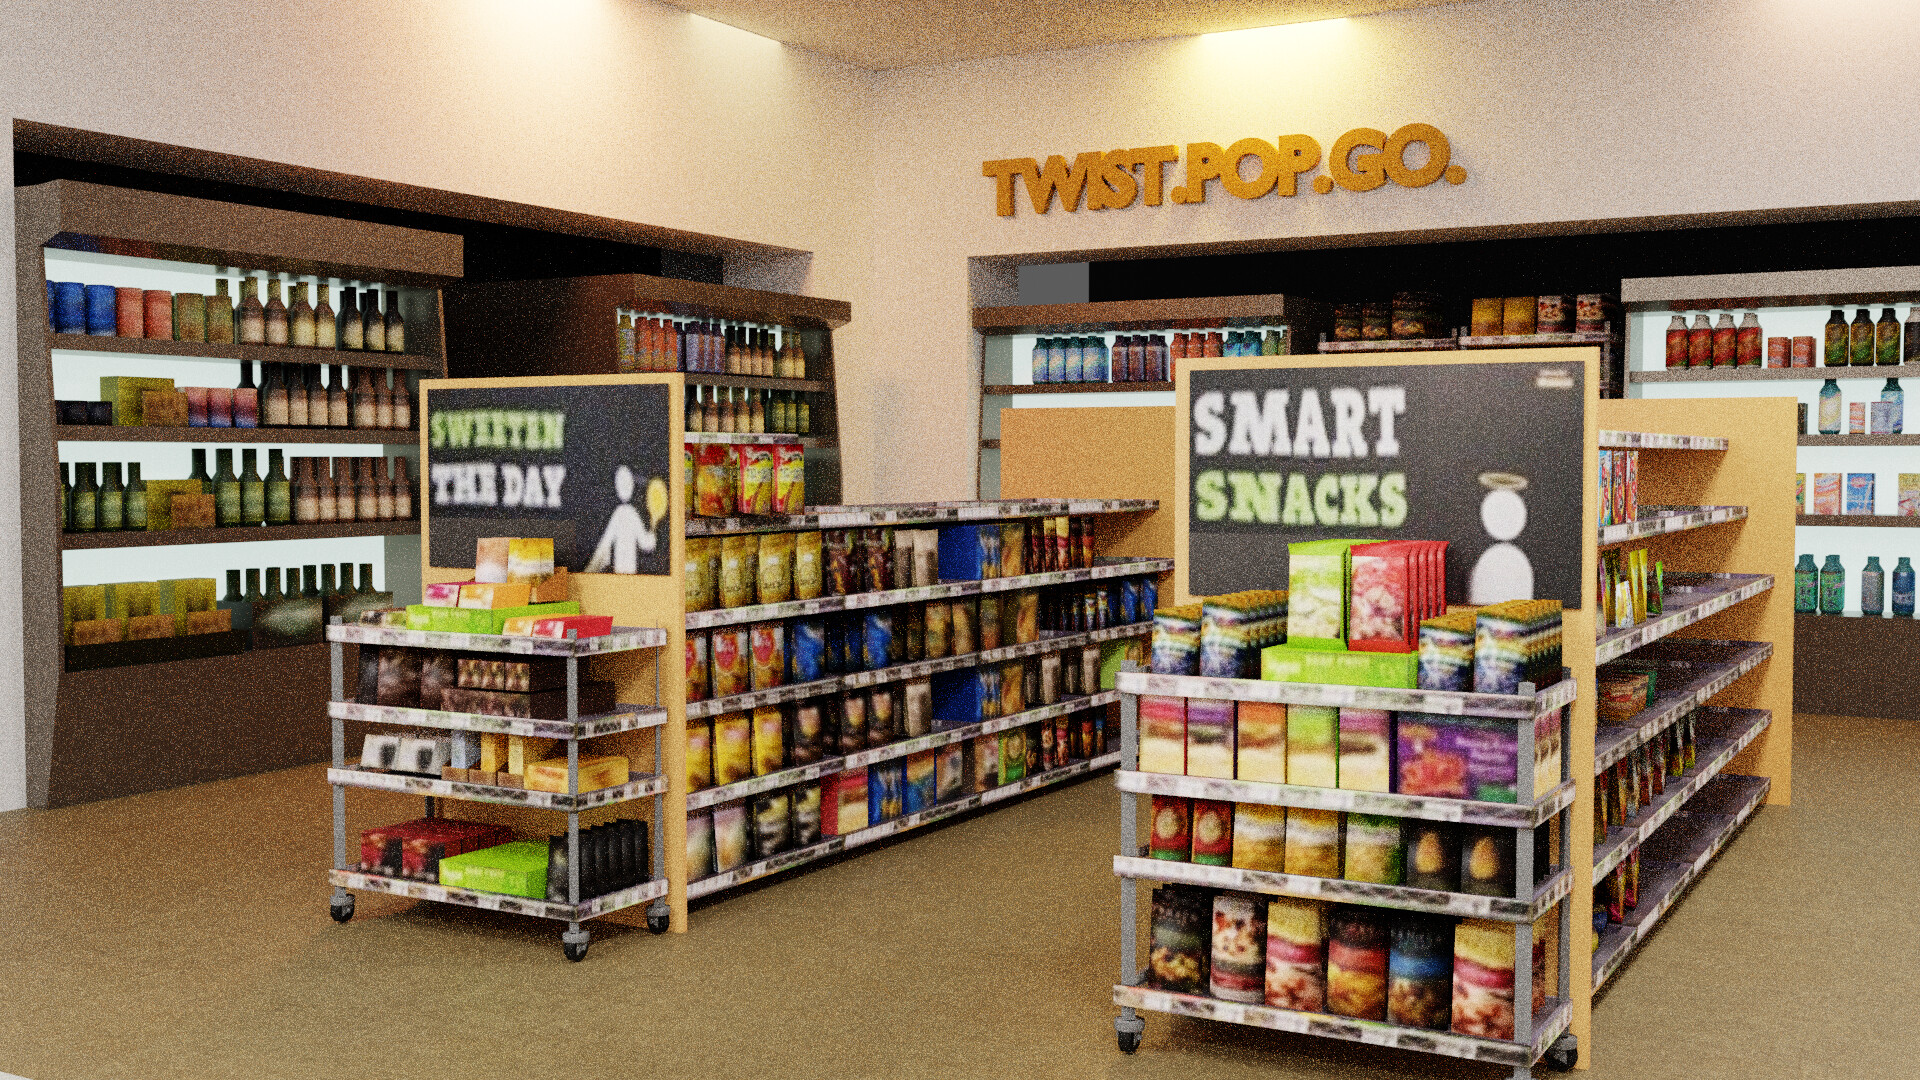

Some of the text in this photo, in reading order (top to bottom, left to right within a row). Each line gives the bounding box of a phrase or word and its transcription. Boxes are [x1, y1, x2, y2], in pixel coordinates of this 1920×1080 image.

[982, 122, 1467, 217] TWIST.POP.GO.
[1194, 385, 1406, 459] SMART
[431, 461, 567, 509] THE DAY
[1195, 469, 1408, 528] SNACKS
